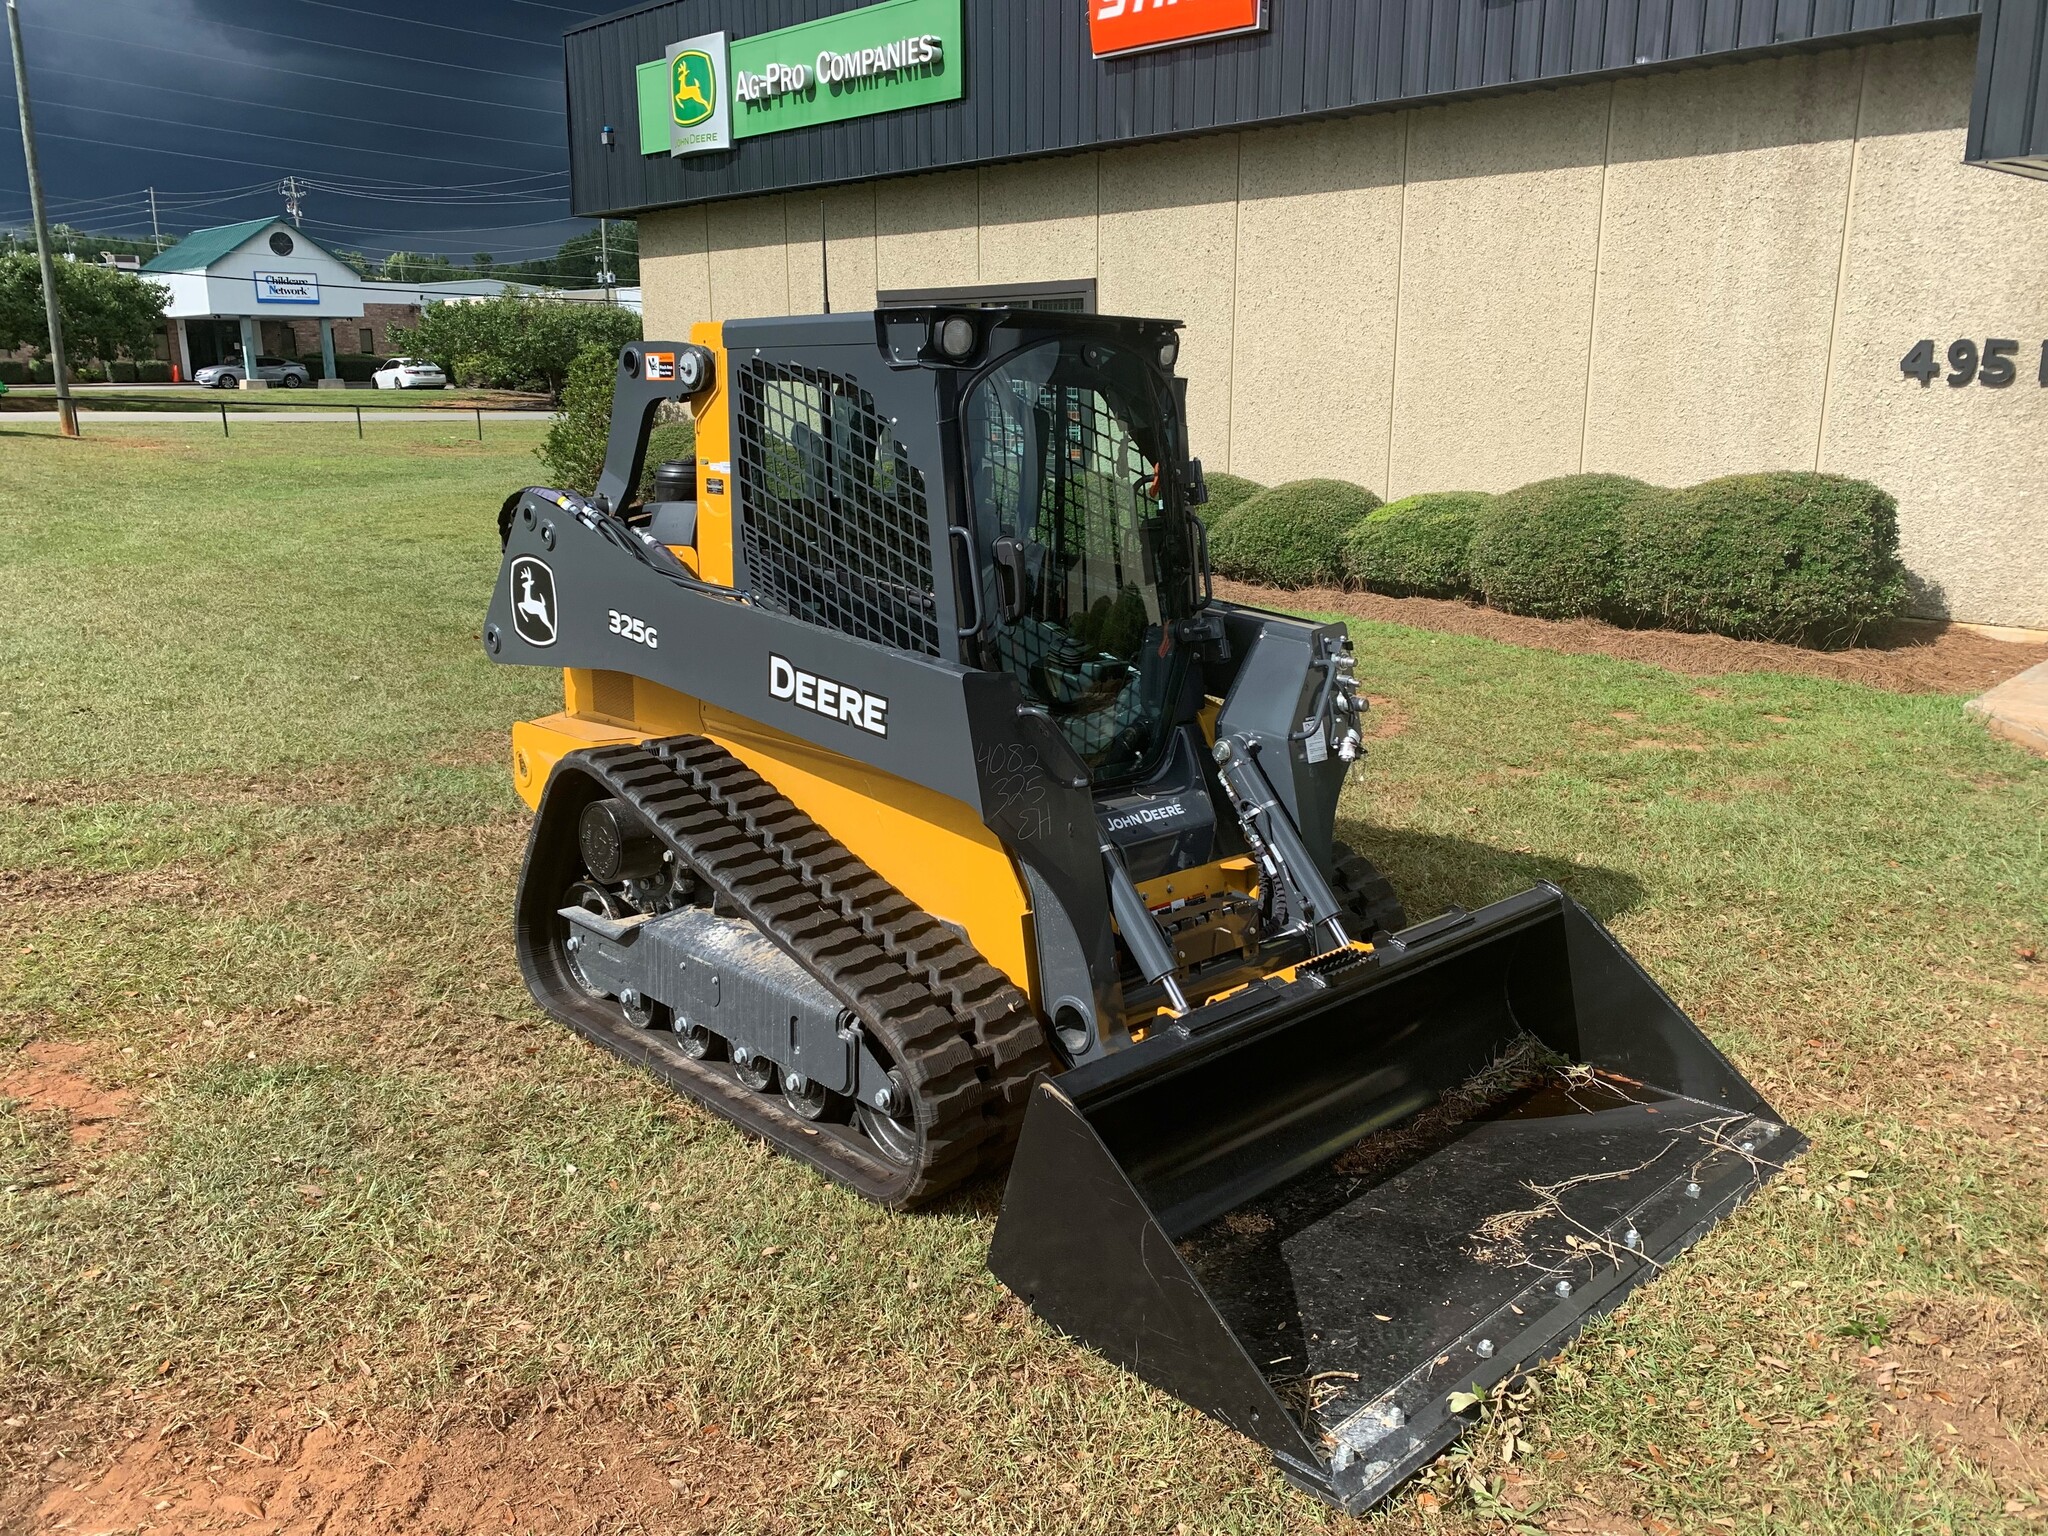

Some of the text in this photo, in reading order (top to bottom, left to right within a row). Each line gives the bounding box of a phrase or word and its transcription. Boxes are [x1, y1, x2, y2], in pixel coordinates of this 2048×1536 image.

[815, 34, 942, 84] COMPANIES
[689, 132, 718, 145] DEERE
[269, 285, 308, 296] Network
[1899, 338, 2019, 388] 495
[608, 609, 658, 650] 325G
[769, 653, 888, 737] DEERE
[977, 743, 1044, 776] 4082
[991, 774, 1046, 819] 325
[1107, 803, 1185, 832] JOHN DEERE
